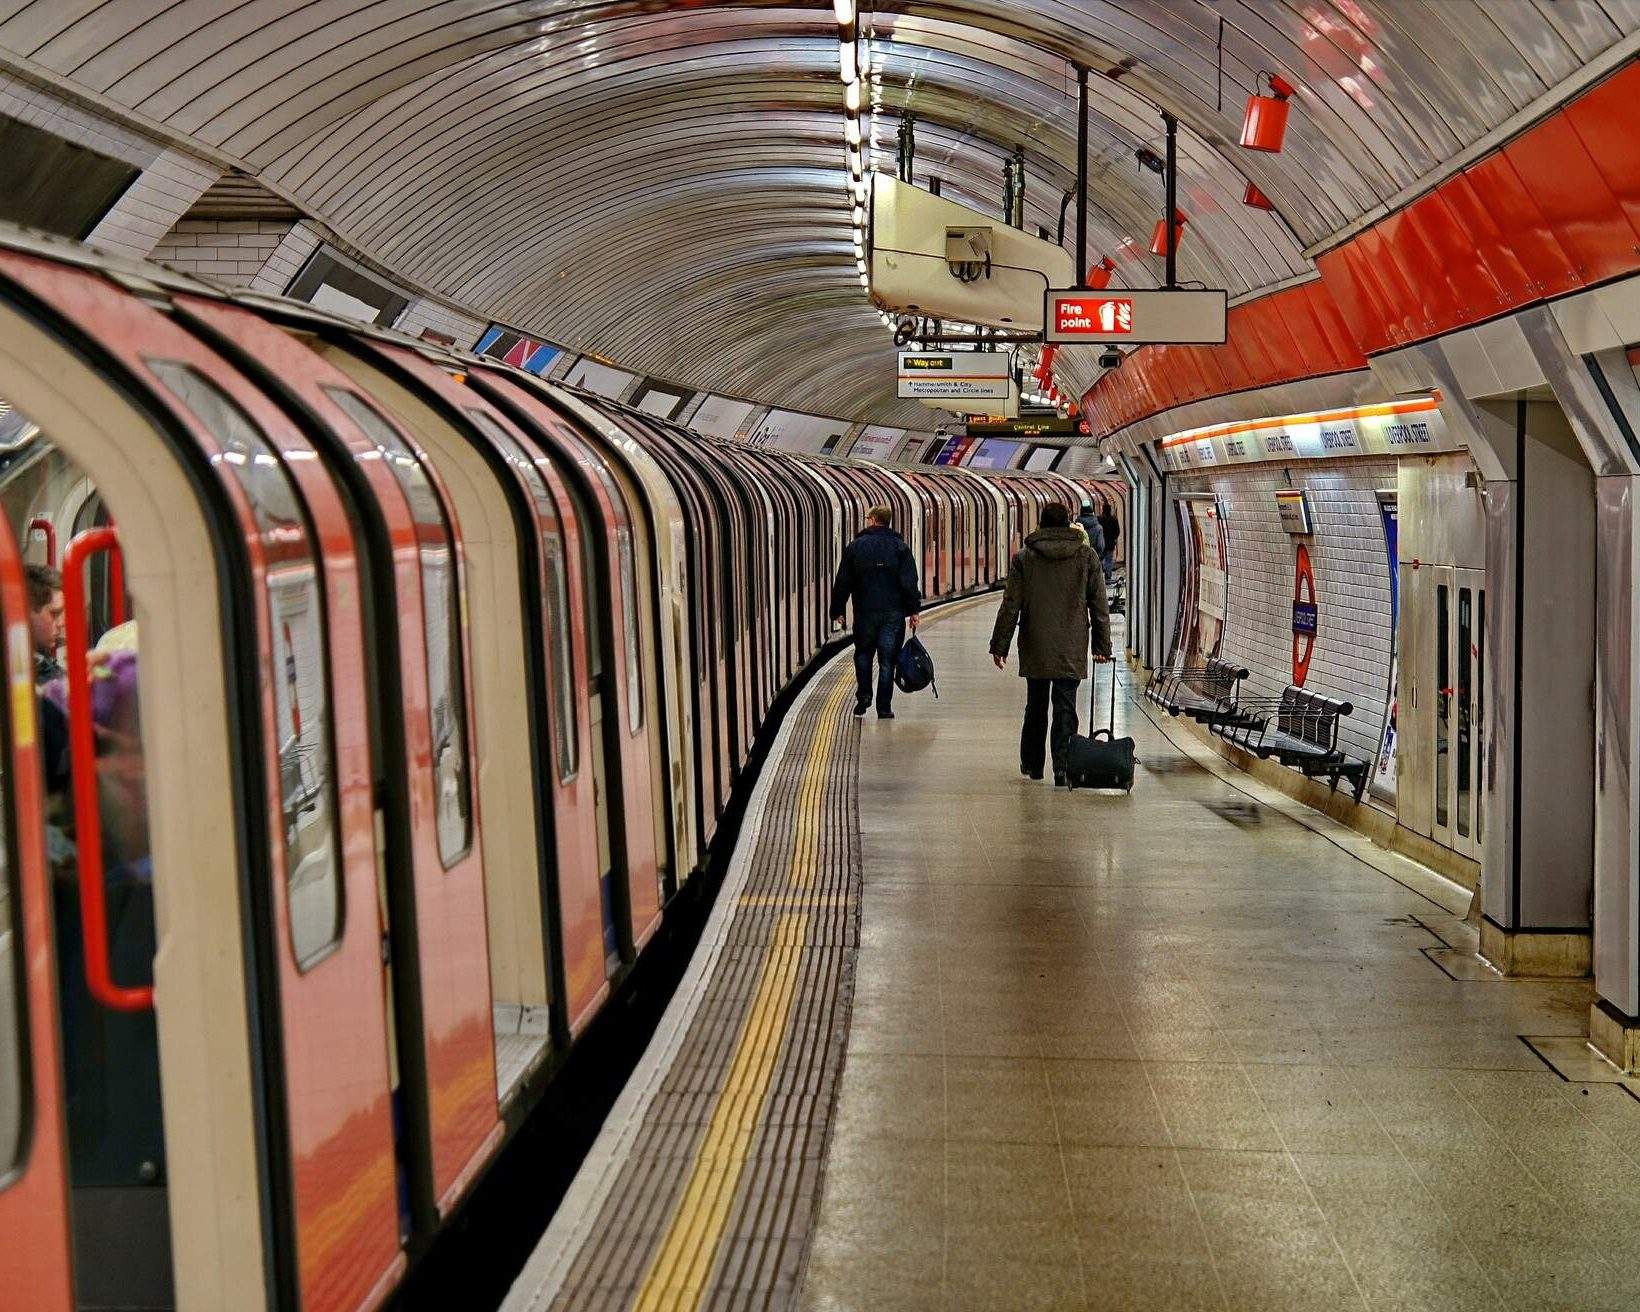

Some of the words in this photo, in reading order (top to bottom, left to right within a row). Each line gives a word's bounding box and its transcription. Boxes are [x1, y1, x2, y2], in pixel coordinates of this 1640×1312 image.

[1060, 303, 1082, 315] Fire
[1060, 317, 1092, 330] point
[913, 359, 929, 368] Way
[960, 381, 973, 389] City
[913, 387, 949, 395] Metropolitan
